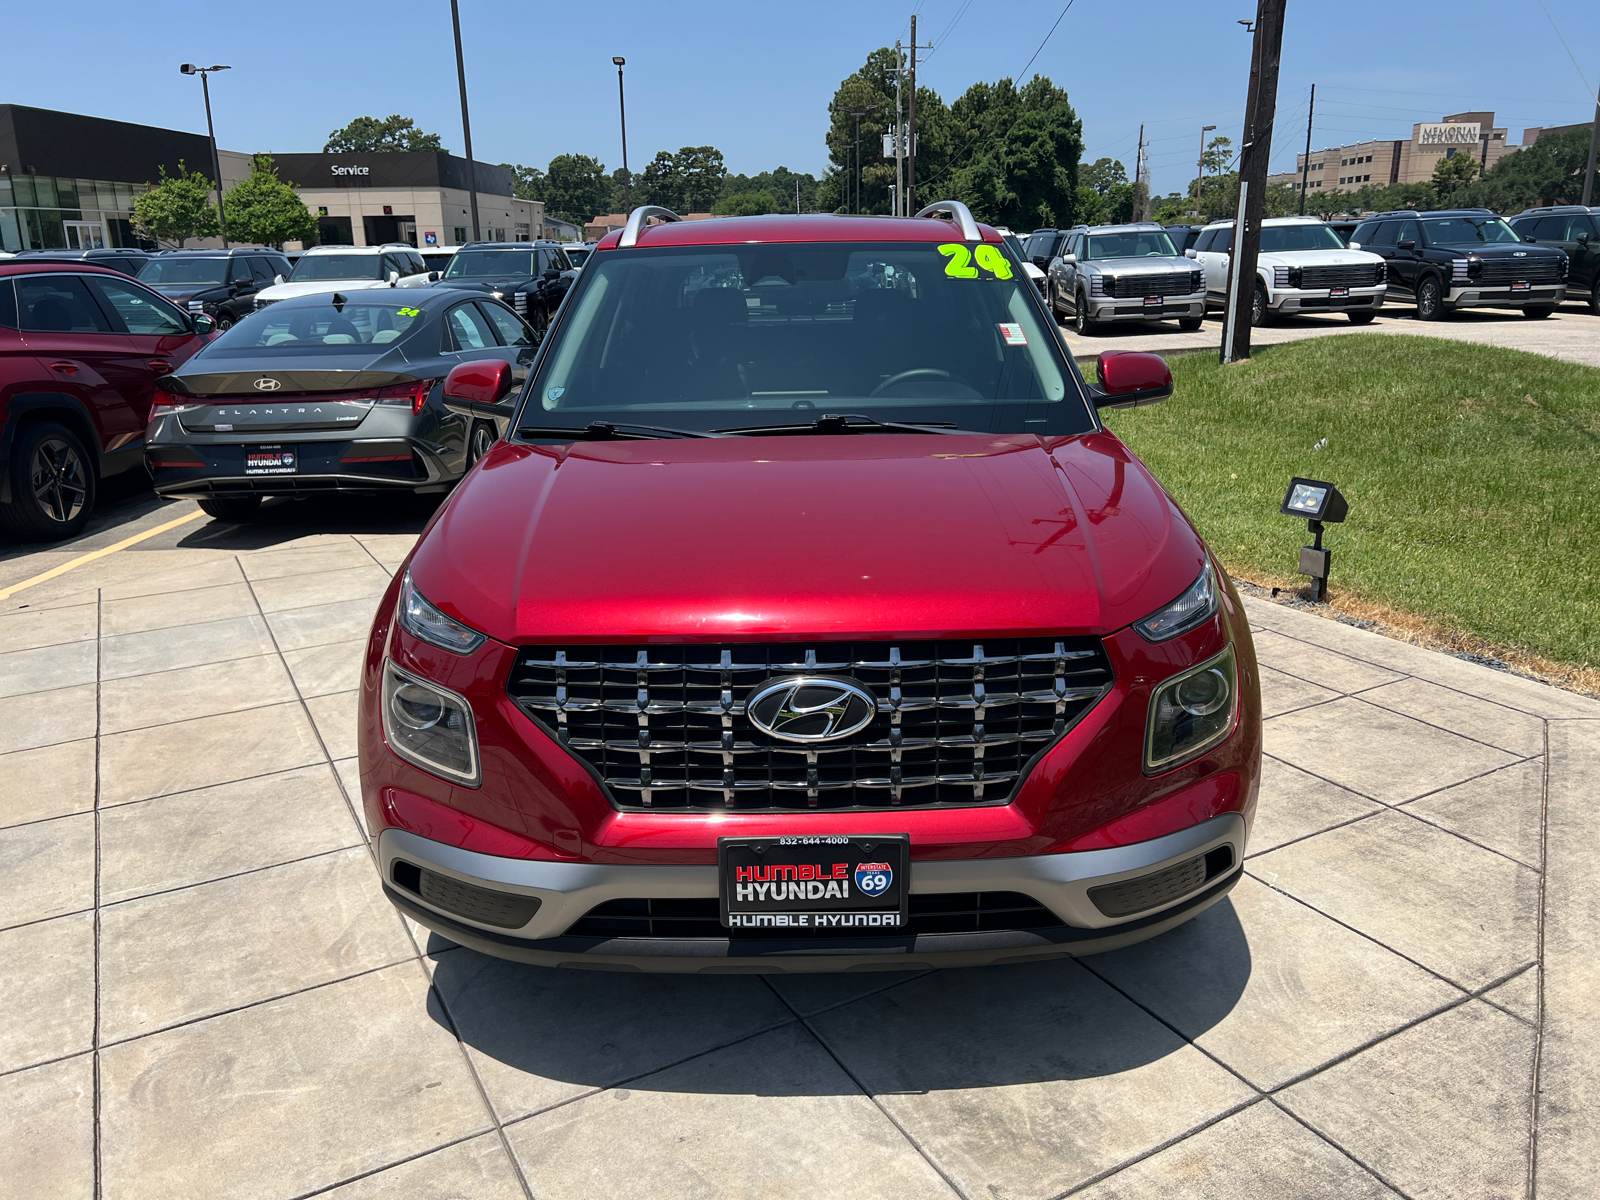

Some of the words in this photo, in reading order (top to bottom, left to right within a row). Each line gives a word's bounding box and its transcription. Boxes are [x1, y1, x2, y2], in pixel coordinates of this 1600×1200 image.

[1423, 126, 1477, 136] MEMORIAL
[1422, 134, 1477, 143] HERMANN
[331, 165, 370, 176] Service
[938, 243, 1013, 280] 24
[396, 307, 420, 317] 24
[219, 407, 322, 415] ELANTRA
[247, 459, 282, 467] HYUNDAI
[779, 837, 849, 845] 832-644-4000
[736, 863, 849, 881] HUMBLE
[861, 875, 887, 891] 69
[736, 880, 849, 901] HYUNDAI
[729, 915, 808, 927] HUMBLE
[815, 914, 900, 926] HYUNDAI
